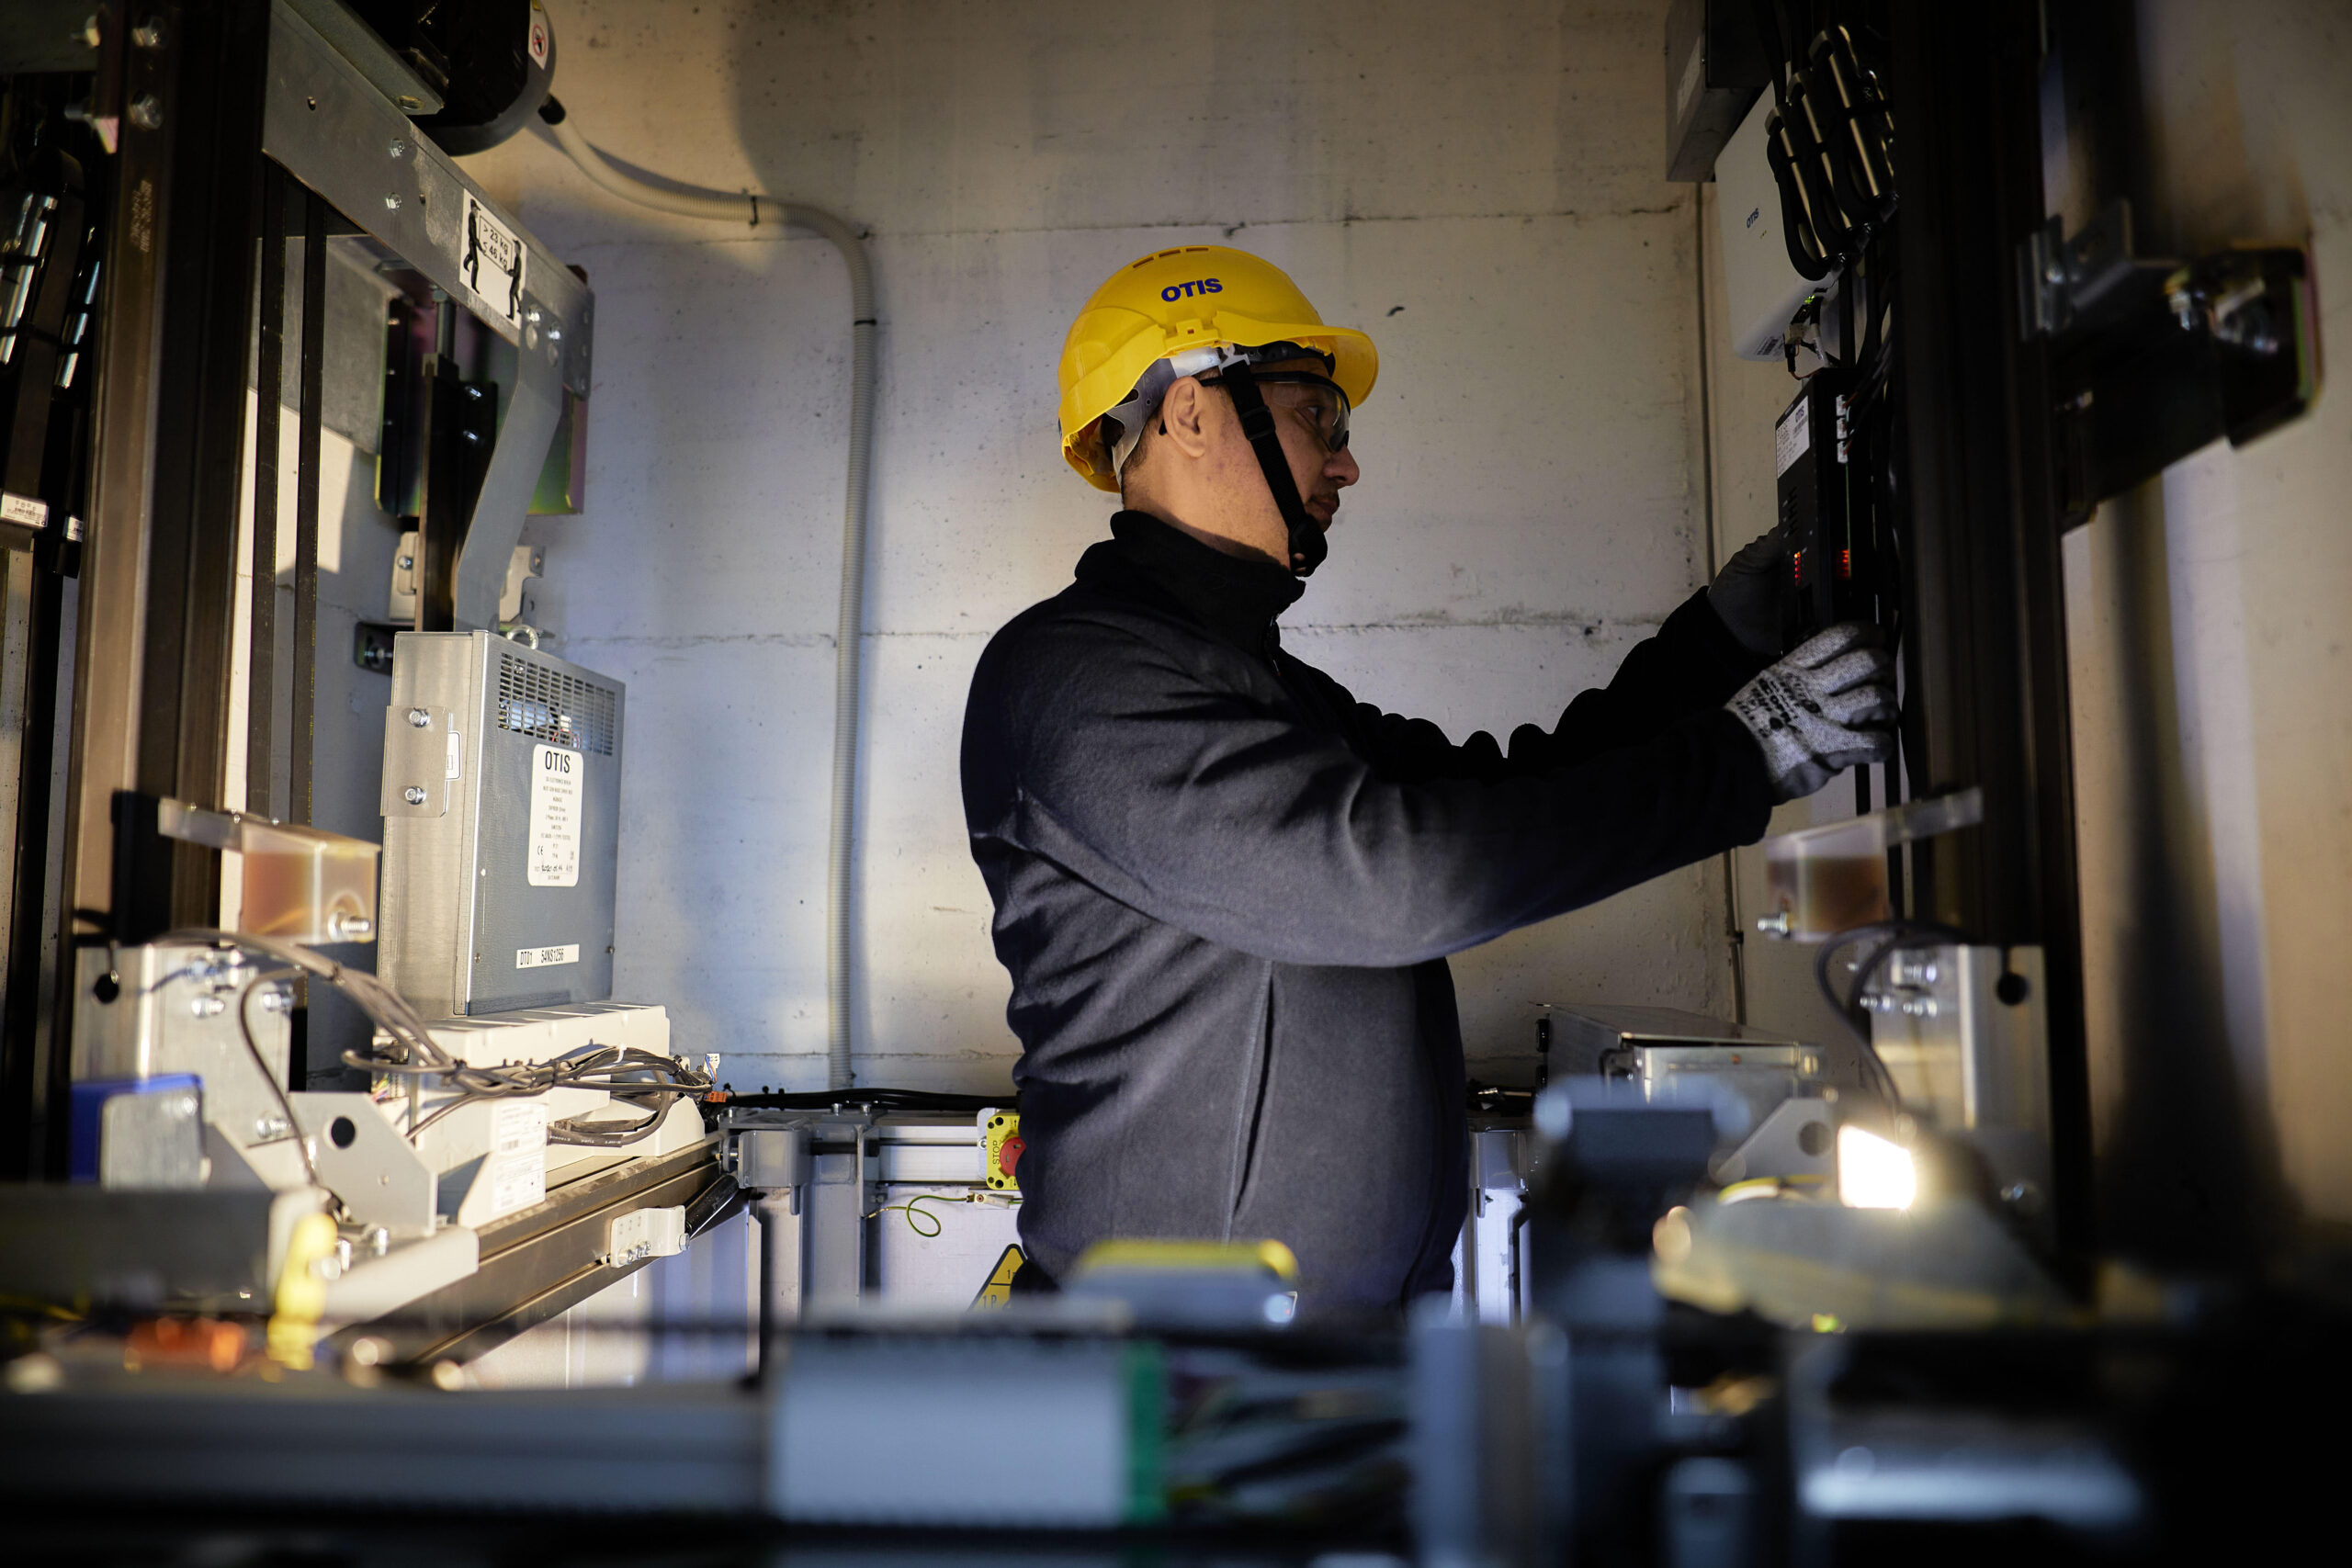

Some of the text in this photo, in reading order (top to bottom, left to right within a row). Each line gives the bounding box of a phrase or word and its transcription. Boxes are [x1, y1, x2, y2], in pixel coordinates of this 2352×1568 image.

[1747, 207, 1759, 229] OTIS
[489, 245, 497, 259] 46
[490, 229, 498, 243] 23
[500, 238, 508, 254] kg
[1161, 278, 1223, 302] OTIS
[545, 750, 571, 773] OTIS
[992, 1140, 1001, 1165] STOP
